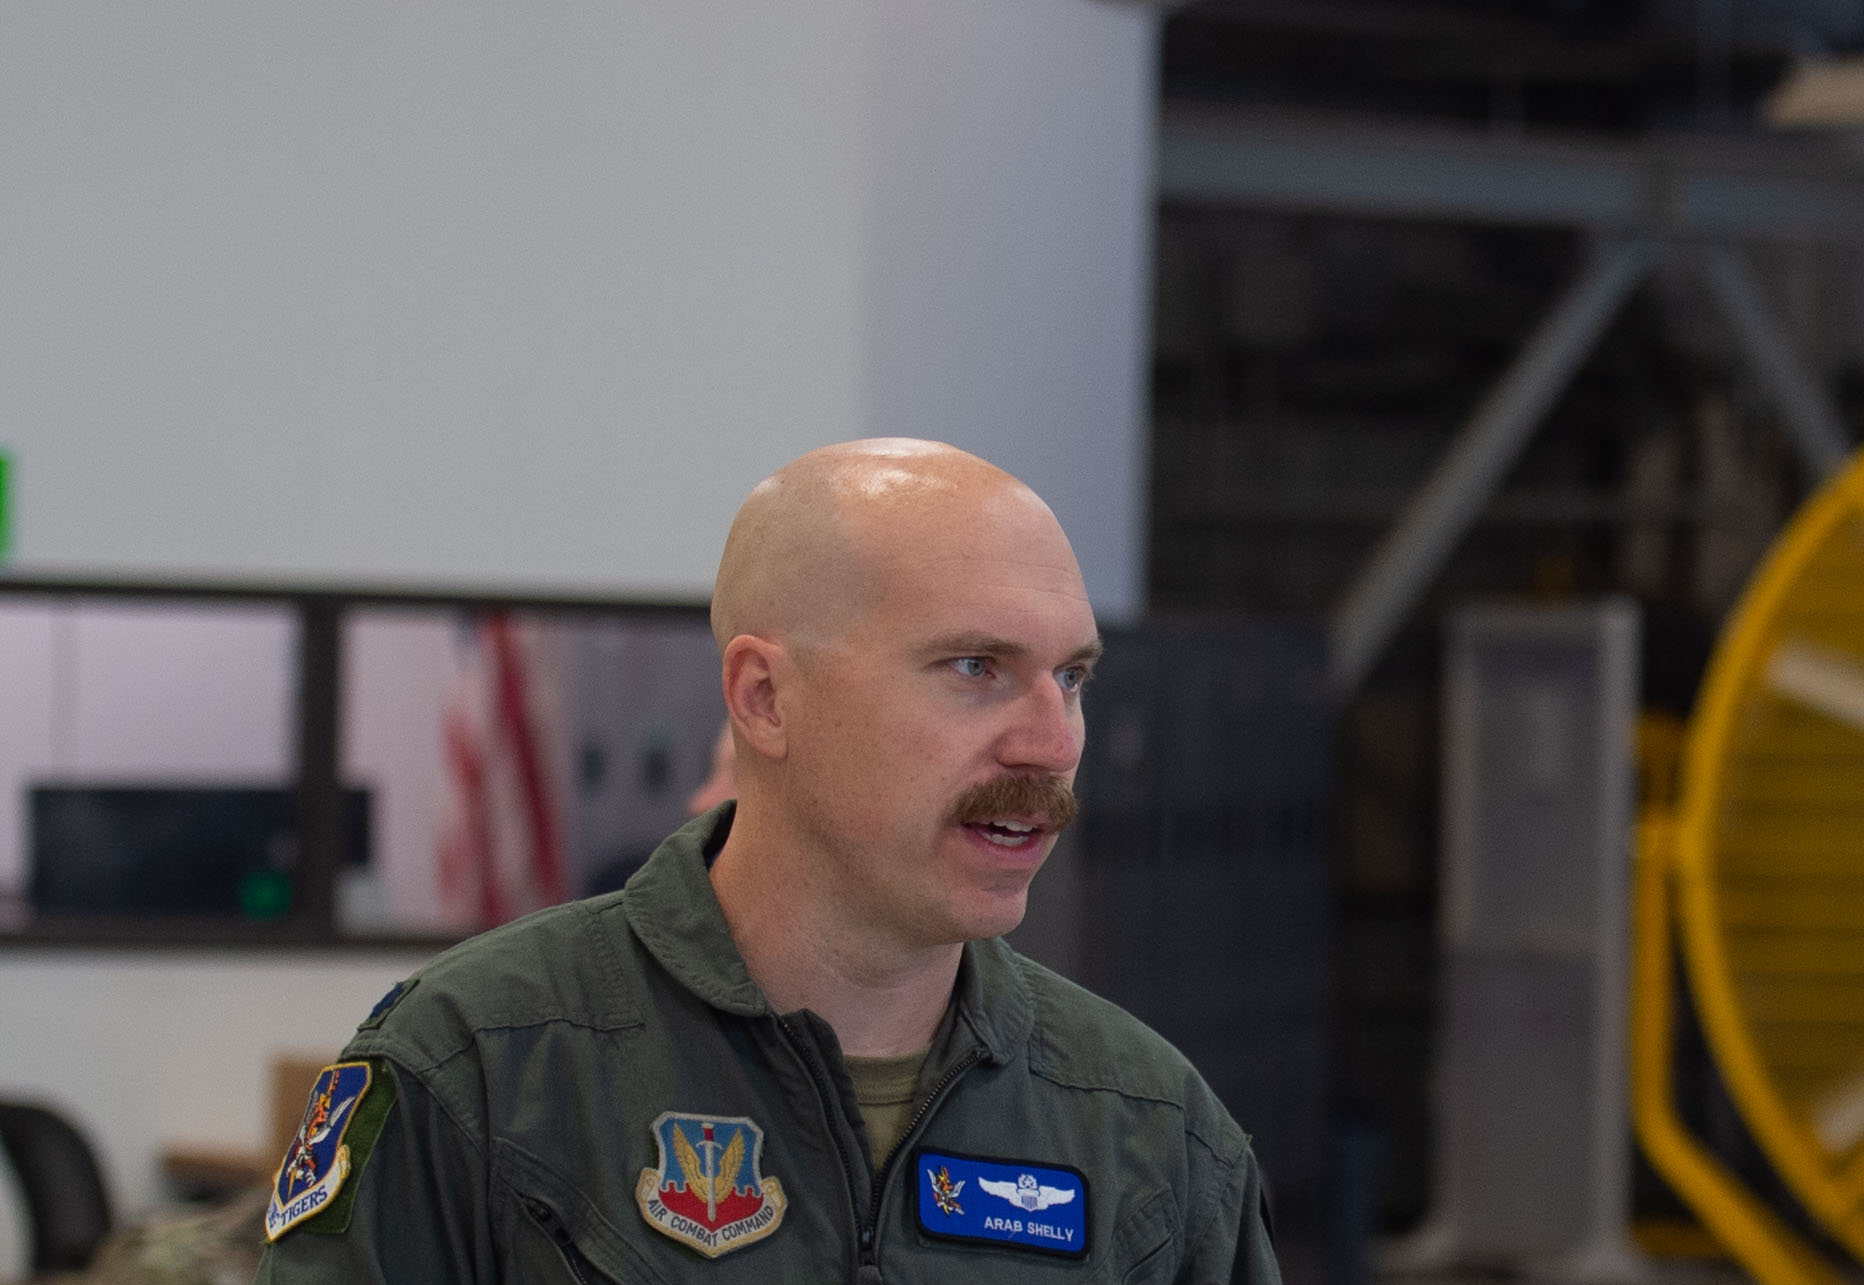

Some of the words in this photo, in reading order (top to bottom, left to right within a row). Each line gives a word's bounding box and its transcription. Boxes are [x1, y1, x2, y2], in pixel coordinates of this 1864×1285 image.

[280, 1184, 329, 1227] TIGERS
[648, 1199, 668, 1222] AIR
[671, 1215, 719, 1247] COMBAT
[721, 1204, 775, 1242] COMMAND
[984, 1216, 1023, 1232] ARAB
[1027, 1221, 1074, 1242] SHELLY
